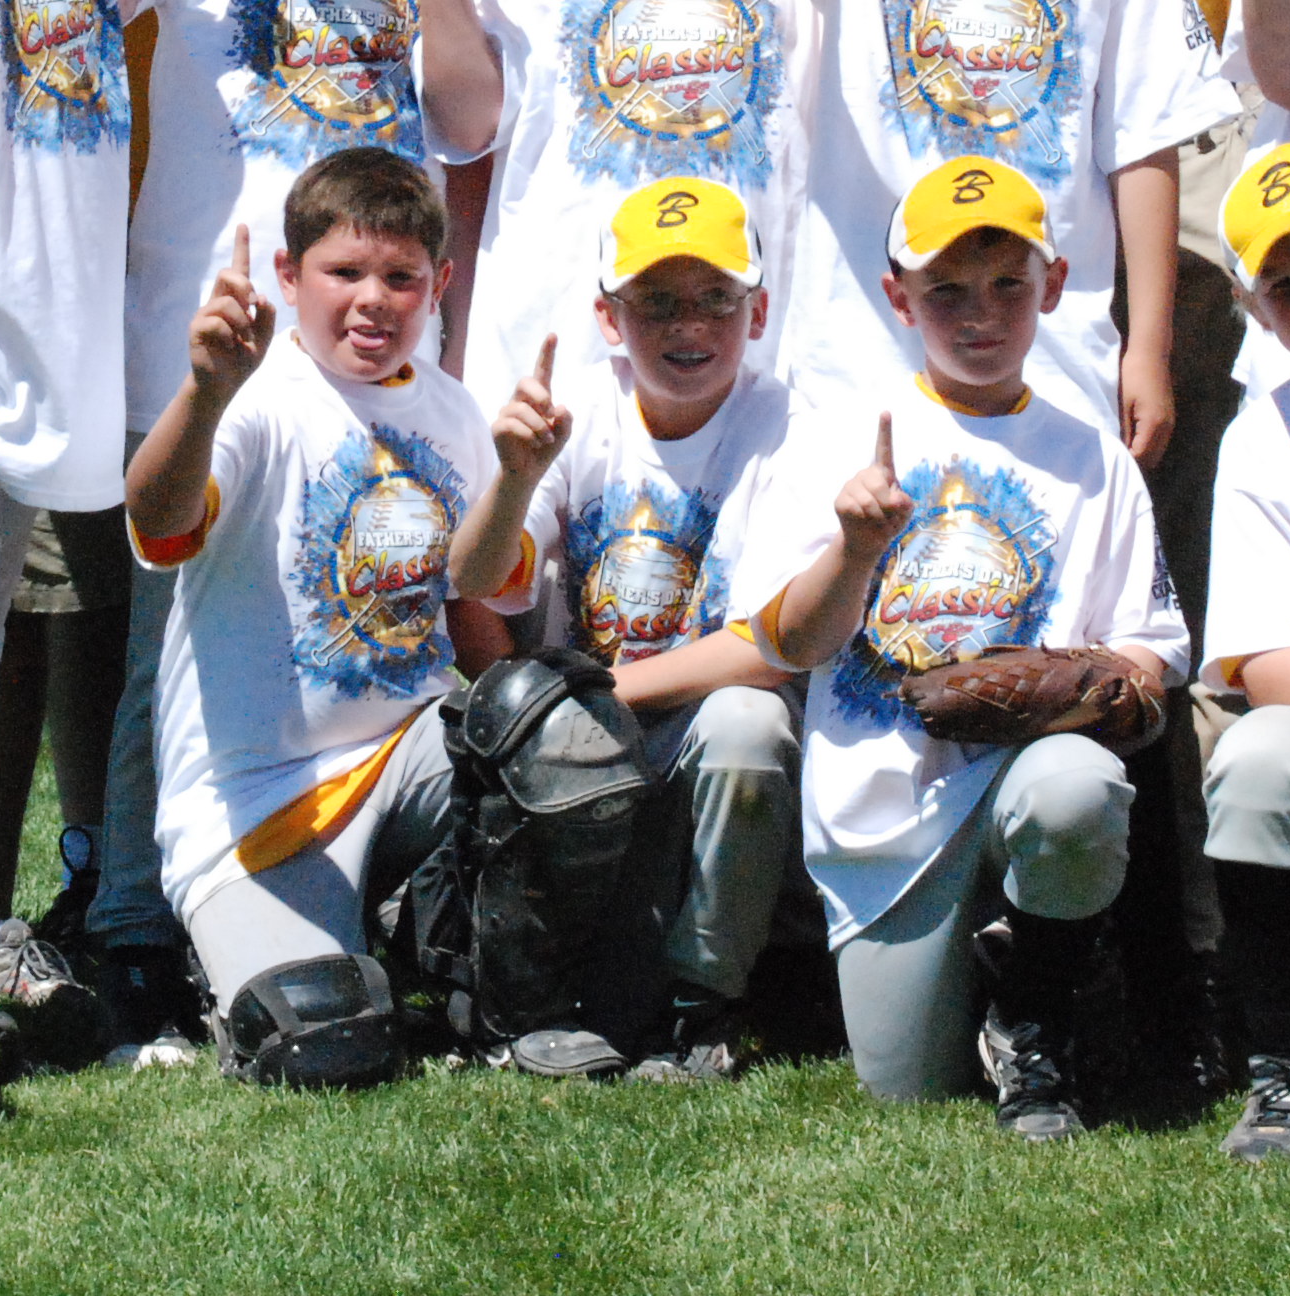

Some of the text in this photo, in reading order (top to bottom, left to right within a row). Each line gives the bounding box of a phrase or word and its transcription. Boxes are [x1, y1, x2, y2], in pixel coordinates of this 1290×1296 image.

[294, 7, 376, 26] FATHER'S
[616, 24, 739, 44] FATHER'S DAY
[999, 23, 1037, 44] DAY
[608, 34, 745, 88] Classic
[953, 170, 994, 204] B
[655, 191, 698, 228] B
[358, 527, 424, 548] FATHER'S
[897, 560, 1015, 591] FATHER'S DAY
[880, 578, 1019, 625] Classic
